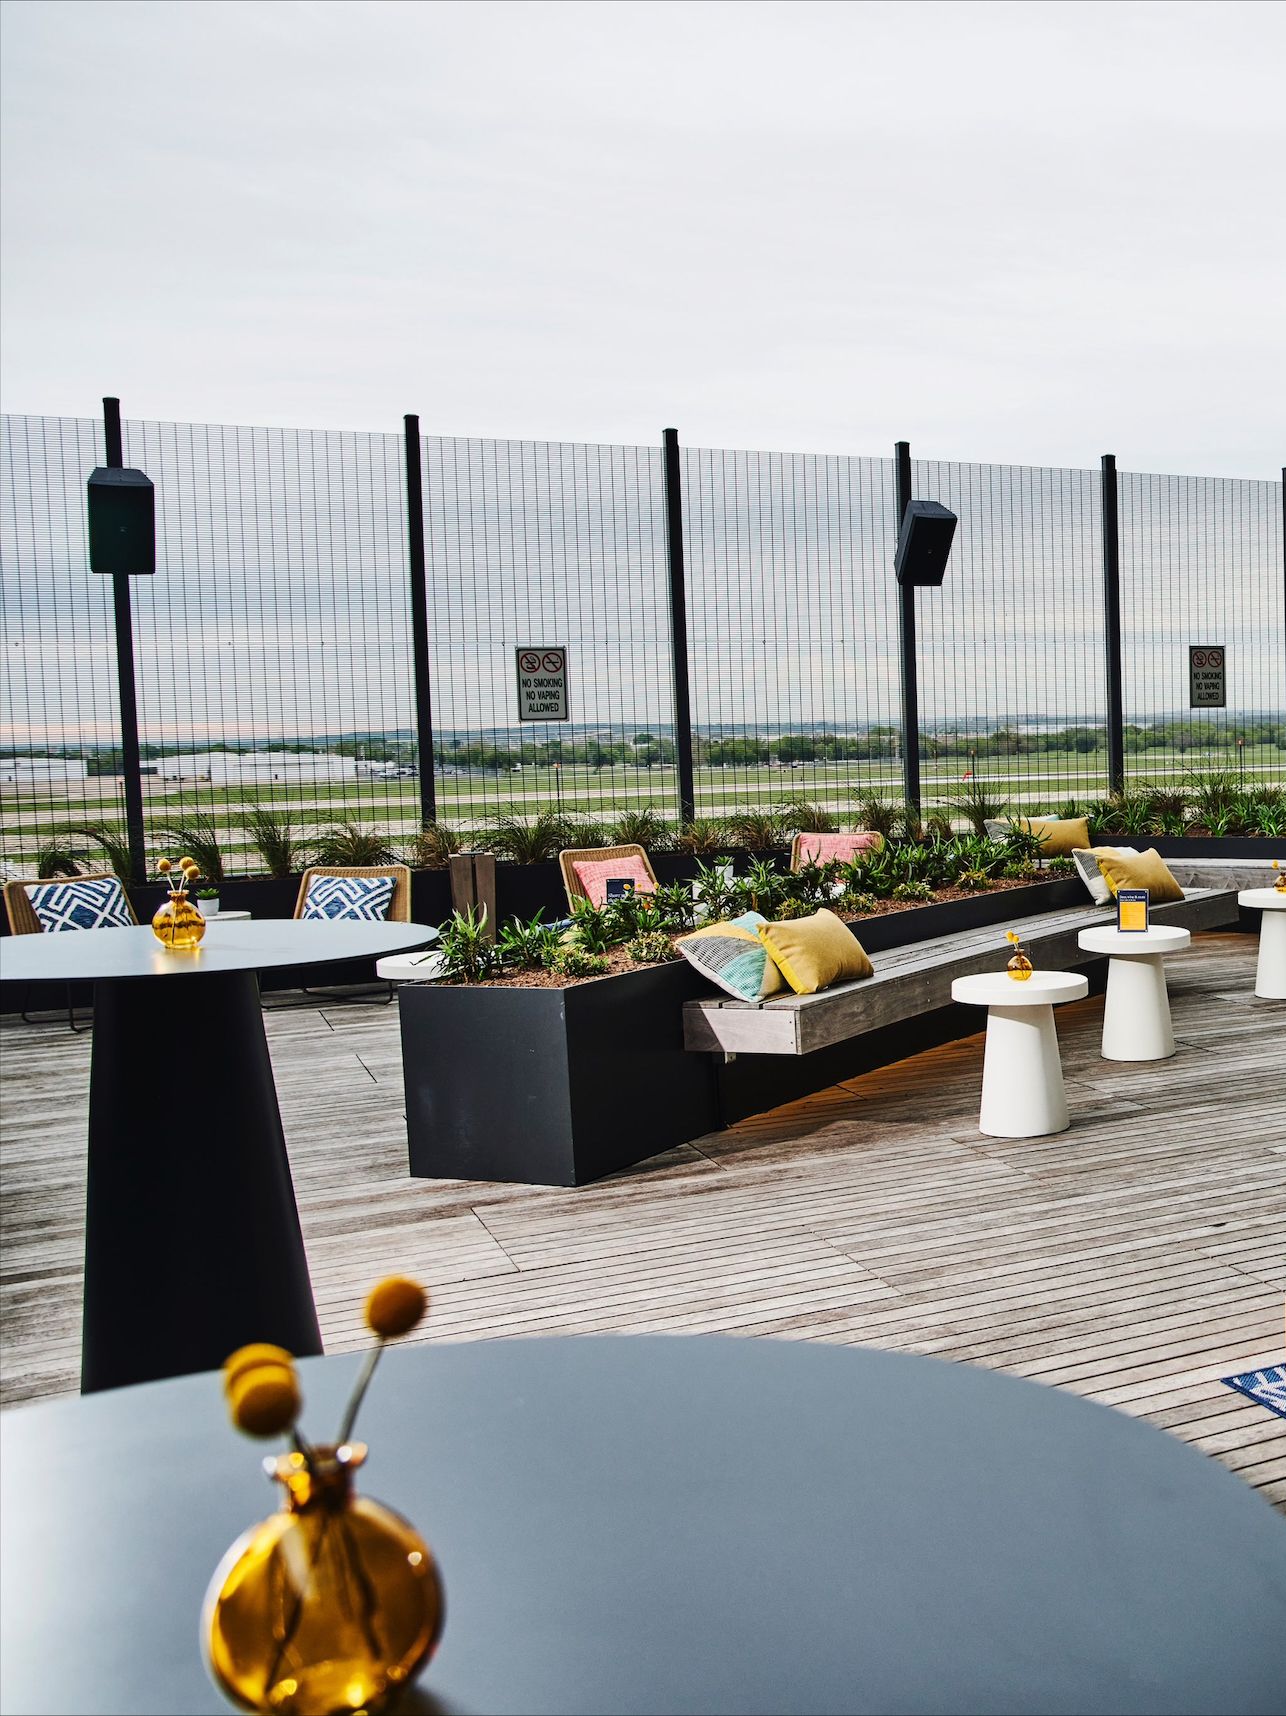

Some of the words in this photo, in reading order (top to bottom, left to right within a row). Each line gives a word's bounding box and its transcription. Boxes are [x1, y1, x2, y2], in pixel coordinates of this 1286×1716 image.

[521, 678, 532, 688] NO
[533, 678, 563, 688] SMOKING
[526, 690, 536, 700] NO
[537, 690, 560, 700] VAPING
[528, 702, 560, 713] ALLOWED
